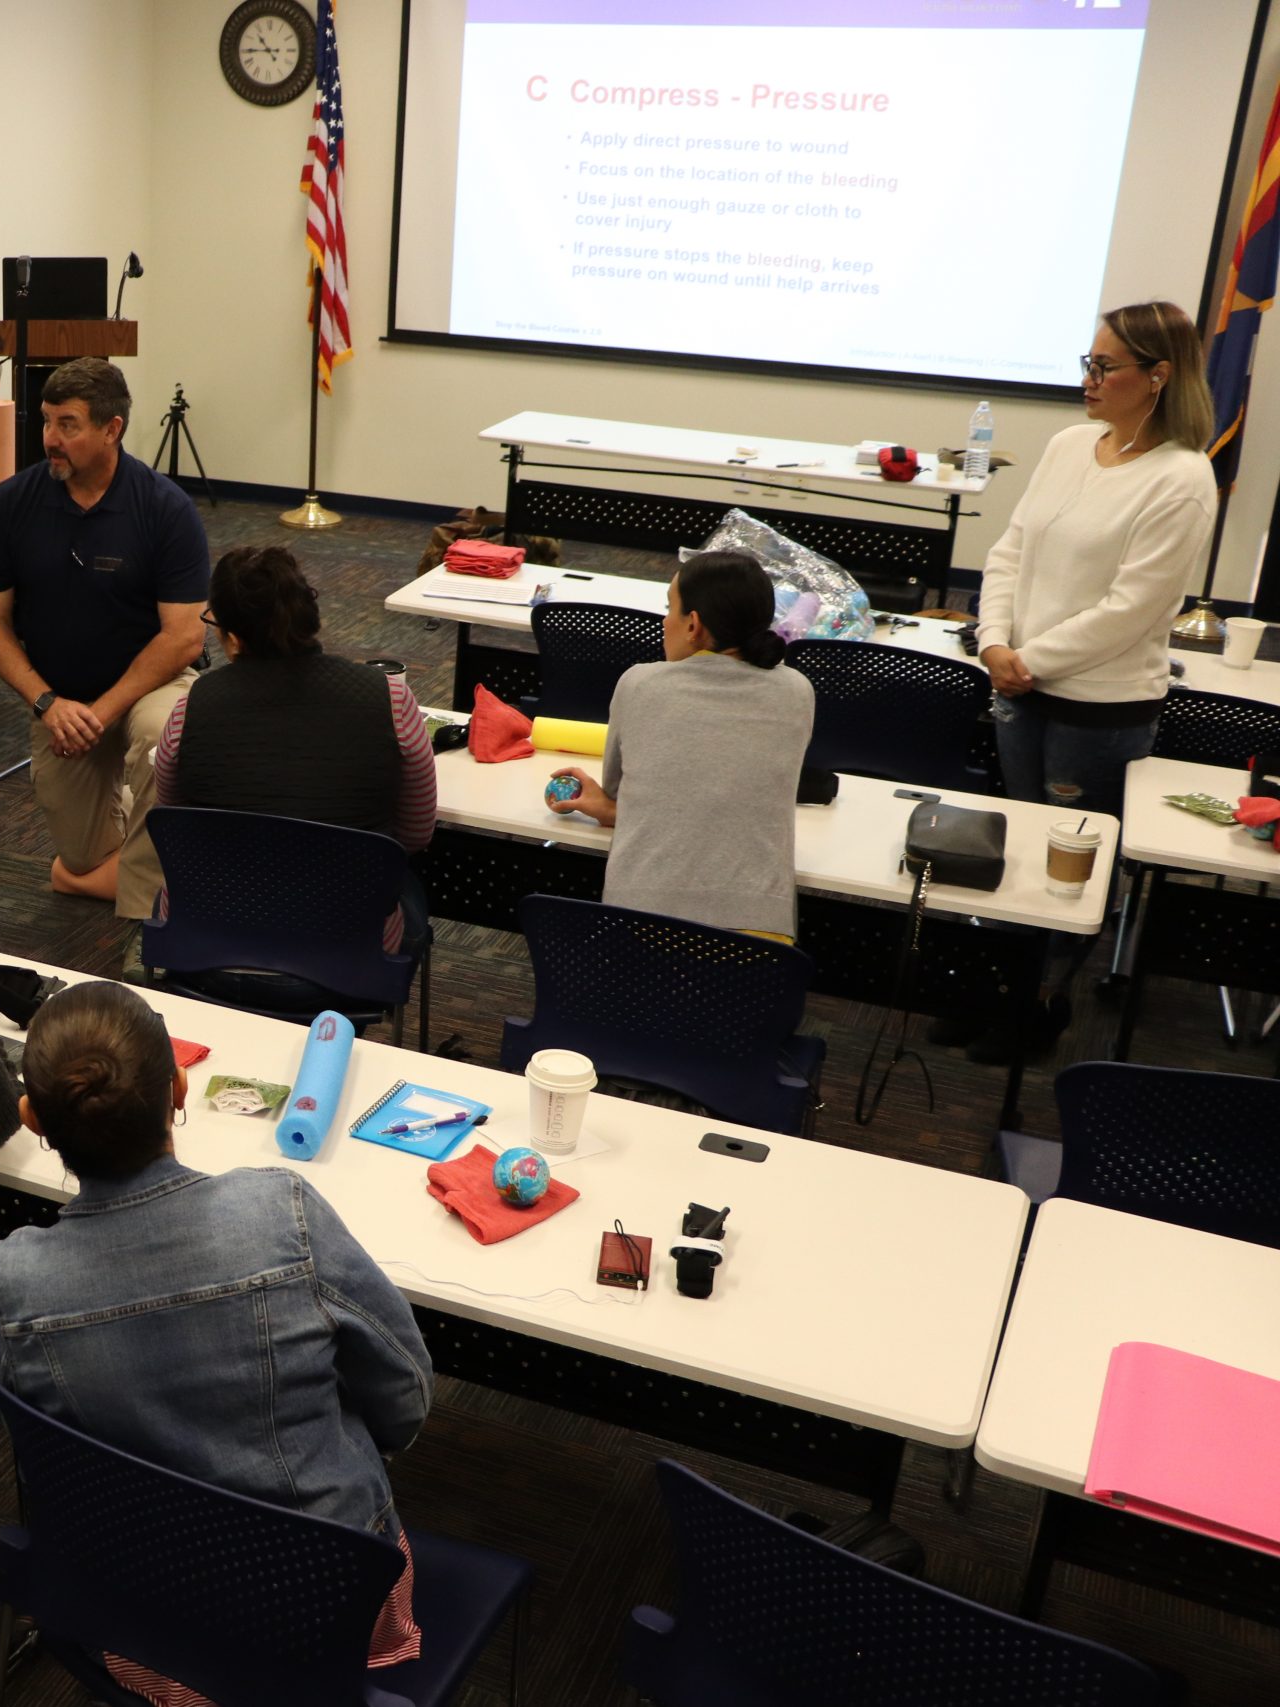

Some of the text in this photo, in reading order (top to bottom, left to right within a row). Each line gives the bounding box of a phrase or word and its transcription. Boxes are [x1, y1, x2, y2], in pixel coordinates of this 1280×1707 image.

[526, 75, 548, 102] C
[571, 79, 719, 111] Compress
[751, 84, 889, 112] Pressure
[580, 131, 848, 154] Apply direct pressure to wound
[579, 161, 898, 192] Focus on the location of the bleeding
[577, 192, 861, 220] Use just enough gauze or cloth to
[576, 215, 672, 232] cover injury
[574, 241, 873, 275] If pressure stops the bleeding, keep
[572, 265, 879, 295] pressure on wound until help arrives
